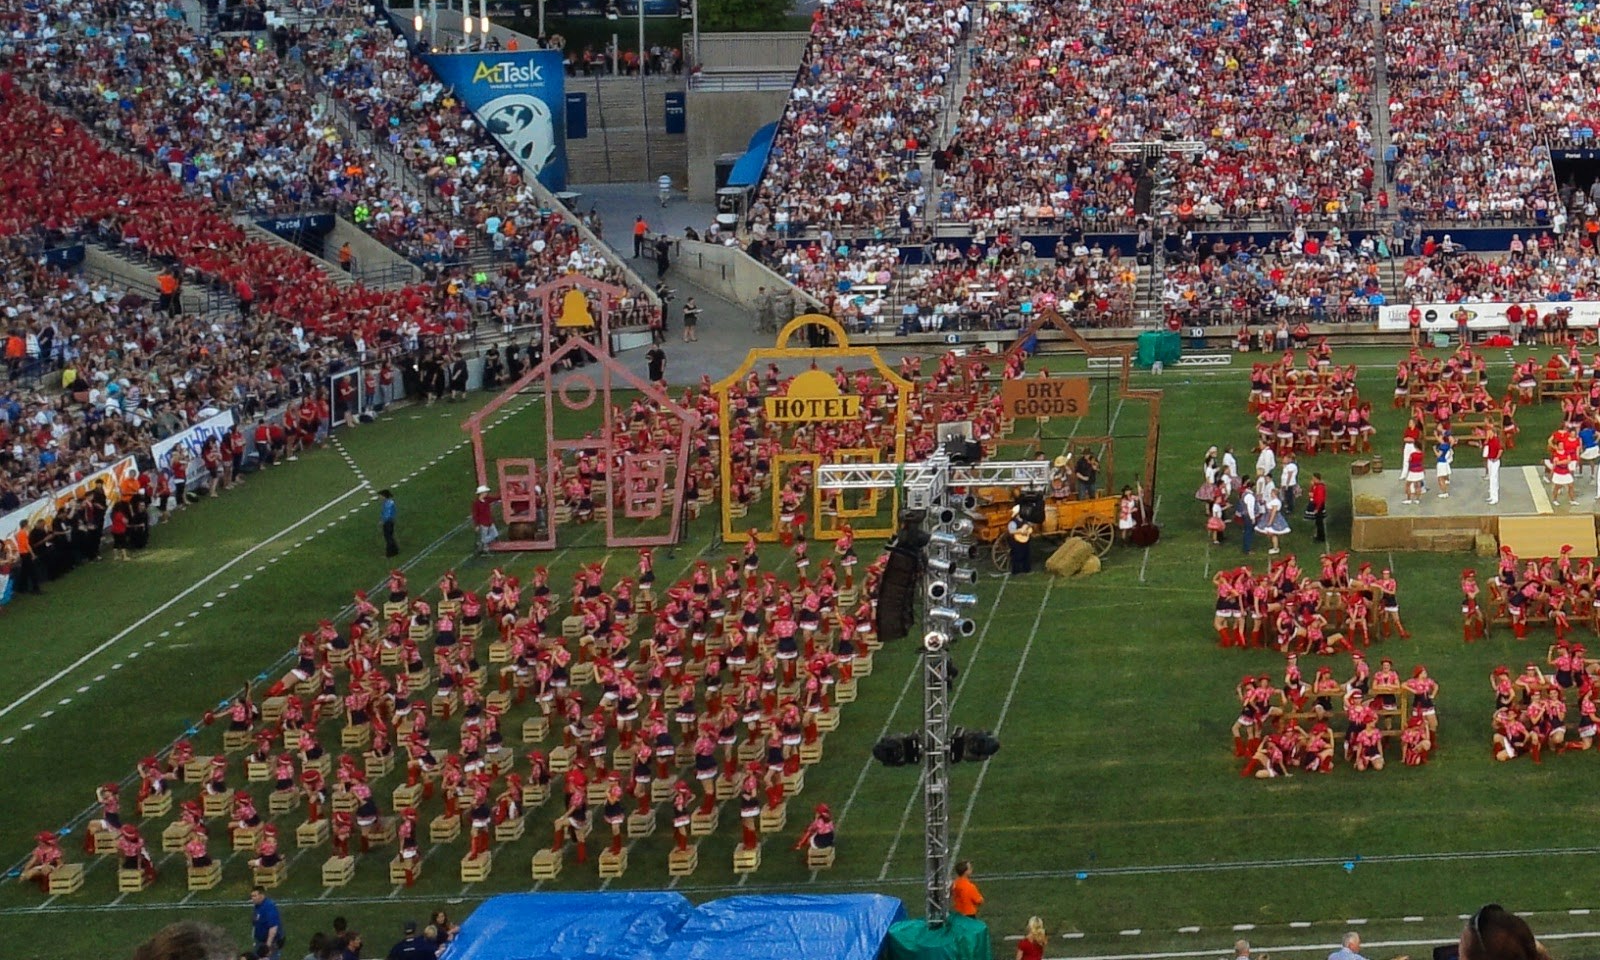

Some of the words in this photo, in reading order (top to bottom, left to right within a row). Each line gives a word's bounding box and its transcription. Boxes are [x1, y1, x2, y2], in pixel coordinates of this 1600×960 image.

[472, 58, 544, 83] AtTask
[311, 218, 316, 227] L
[948, 334, 956, 343] G
[1192, 328, 1203, 336] 10
[1027, 382, 1064, 398] DRY
[774, 399, 856, 418] HOTEL
[1014, 399, 1078, 415] GOODS
